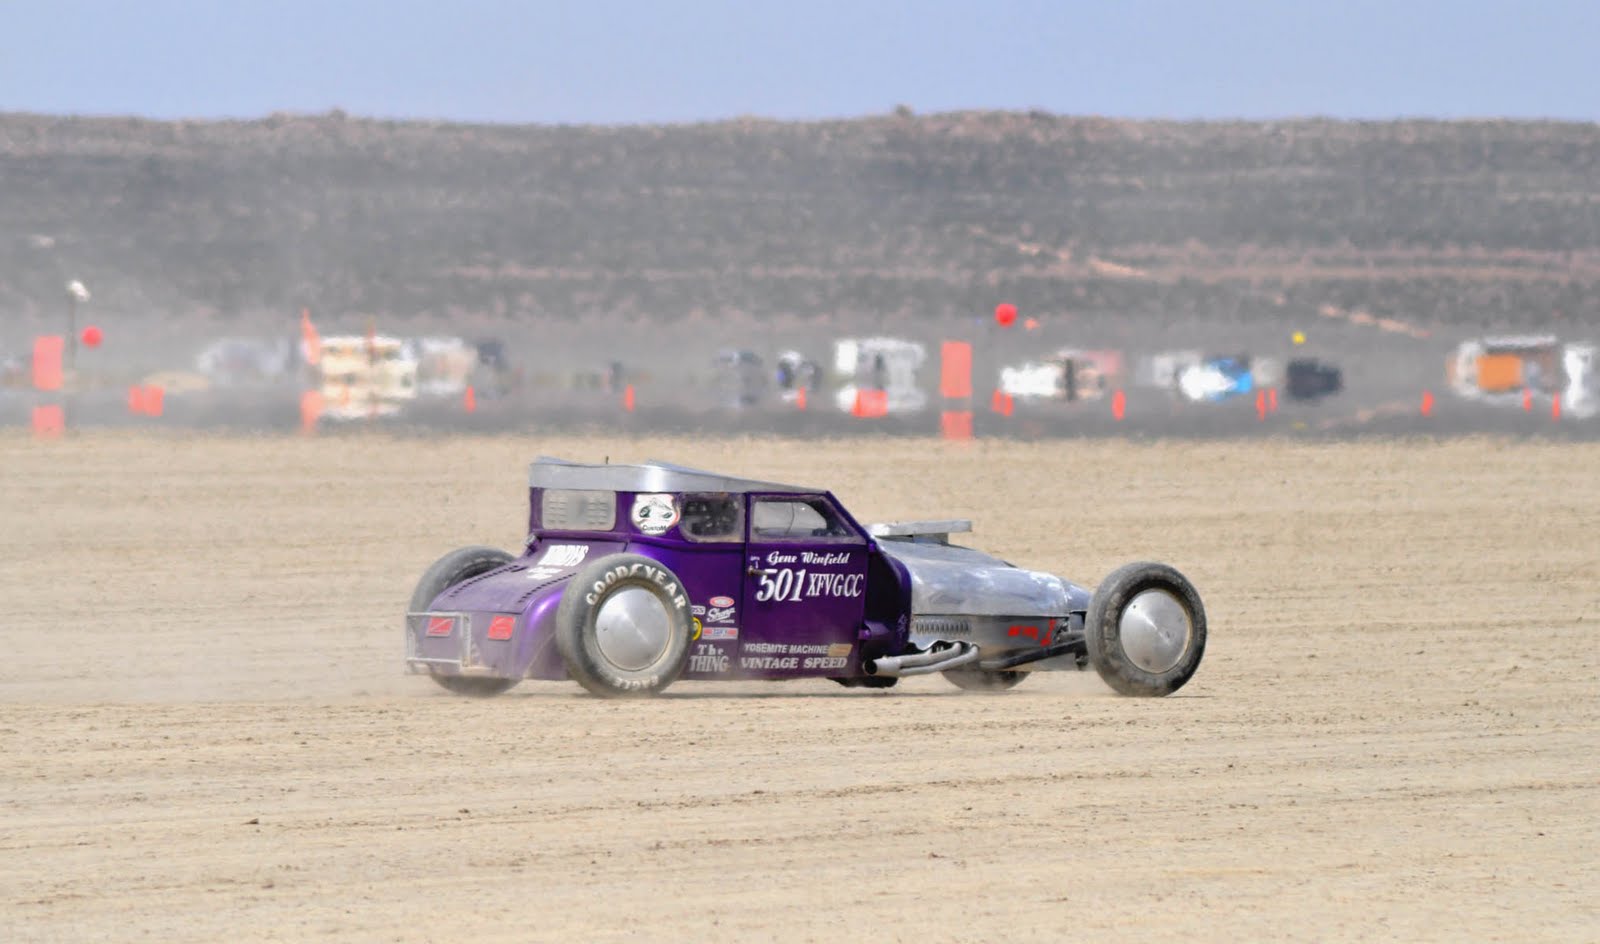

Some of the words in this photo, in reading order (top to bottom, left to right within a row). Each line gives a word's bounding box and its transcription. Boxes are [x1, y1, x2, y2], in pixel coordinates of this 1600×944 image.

[767, 551, 797, 566] Gene
[801, 552, 851, 566] Winfield
[756, 568, 807, 601] 501
[806, 573, 864, 597] XFVGCC
[698, 644, 724, 656] The
[744, 643, 787, 654] YOSEMITE
[789, 645, 828, 654] MACHINE
[689, 655, 729, 672] THING
[741, 657, 799, 669] VINTAGE
[803, 658, 848, 669] SPEED
